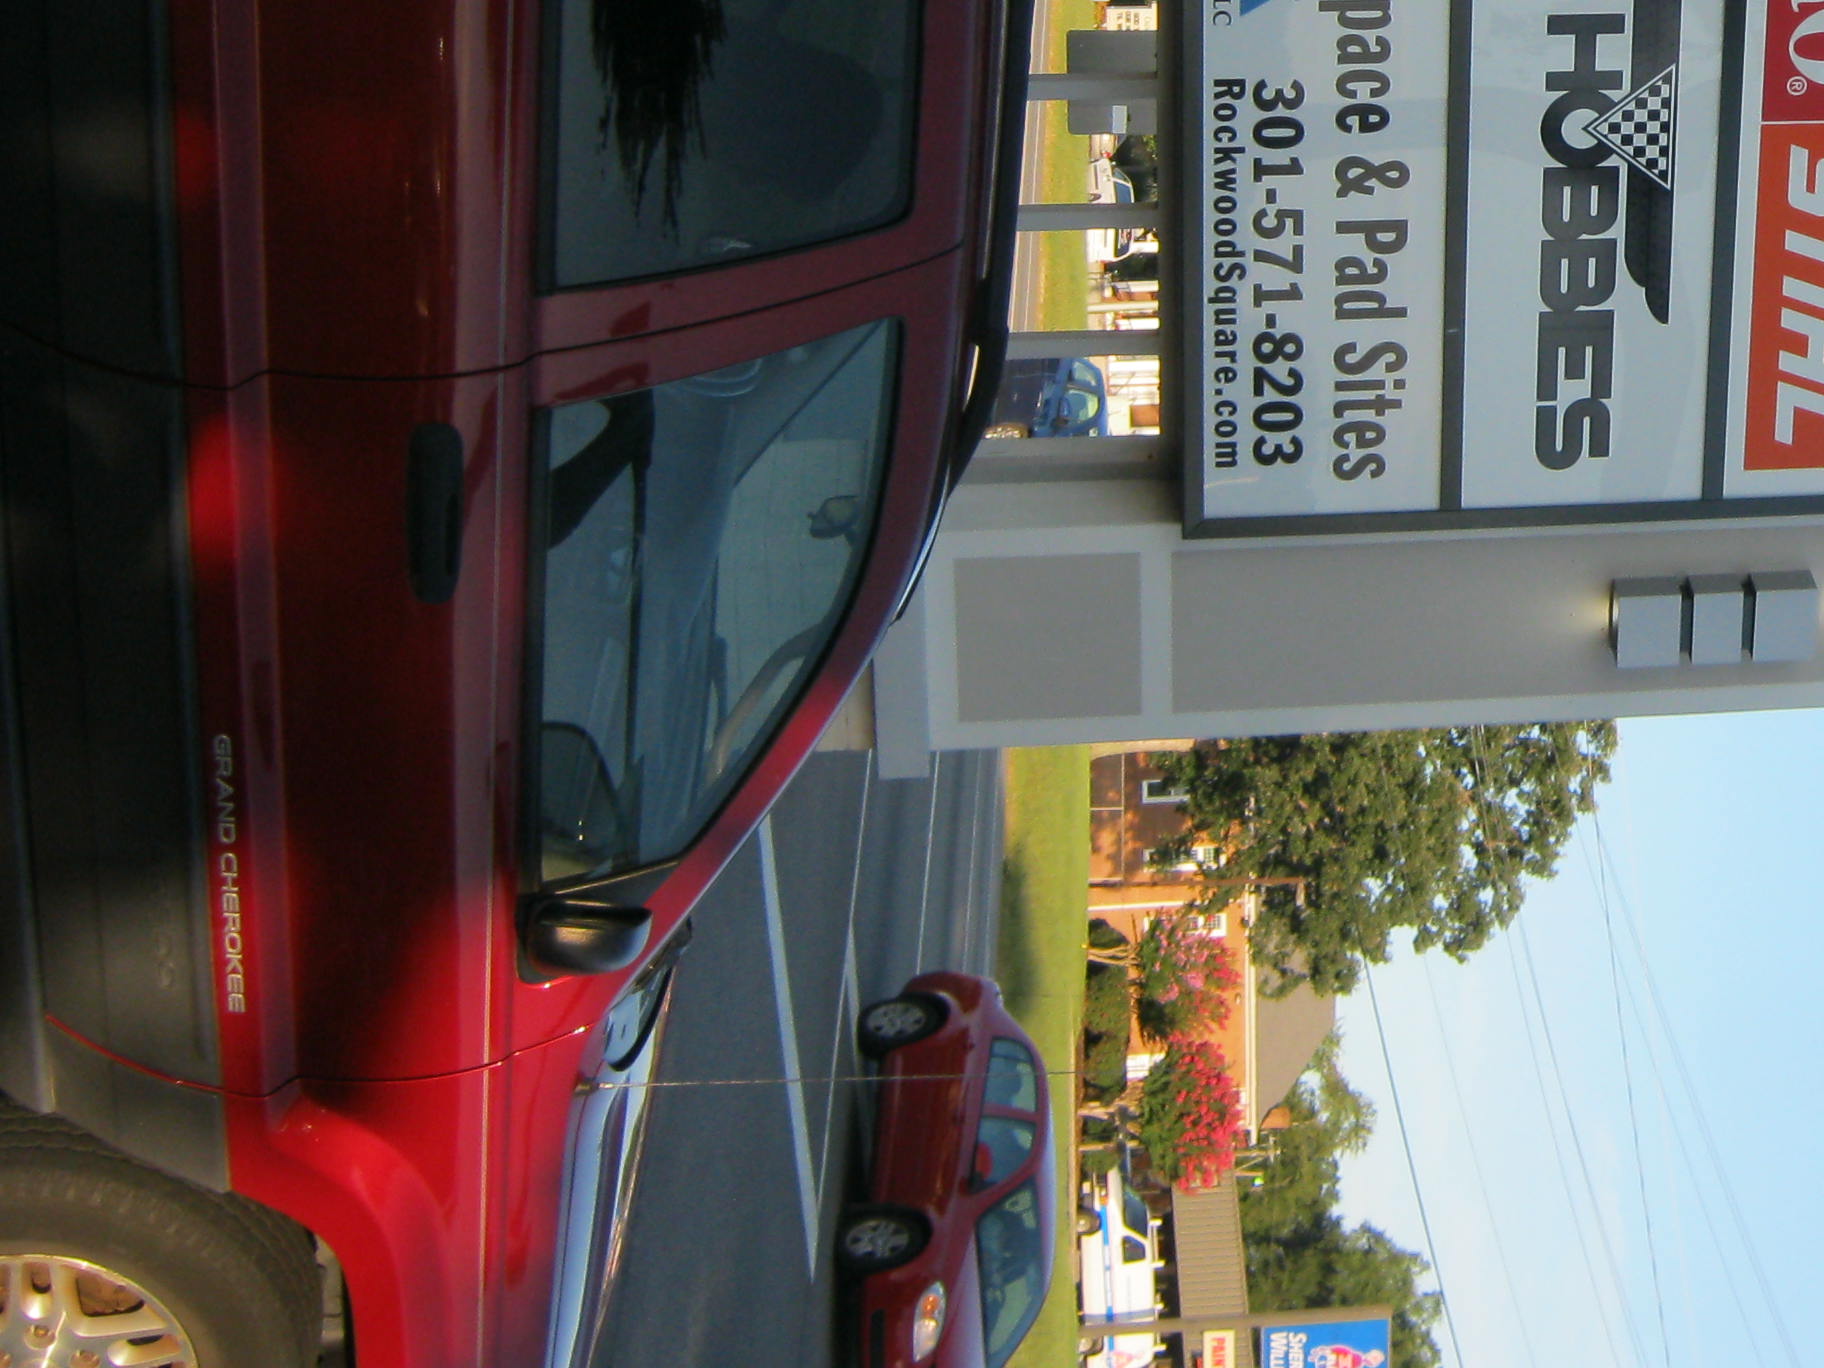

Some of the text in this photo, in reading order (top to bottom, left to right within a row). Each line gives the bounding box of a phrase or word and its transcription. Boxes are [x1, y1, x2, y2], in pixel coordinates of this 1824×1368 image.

[1207, 77, 1247, 469] RockwoodSquare.com
[1252, 77, 1306, 467] 301-571-8203
[1334, 155, 1411, 199] &
[1334, 218, 1409, 321] Pad
[1332, 341, 1409, 482] Sites
[212, 734, 246, 1014] GRAND CHEROKEE
